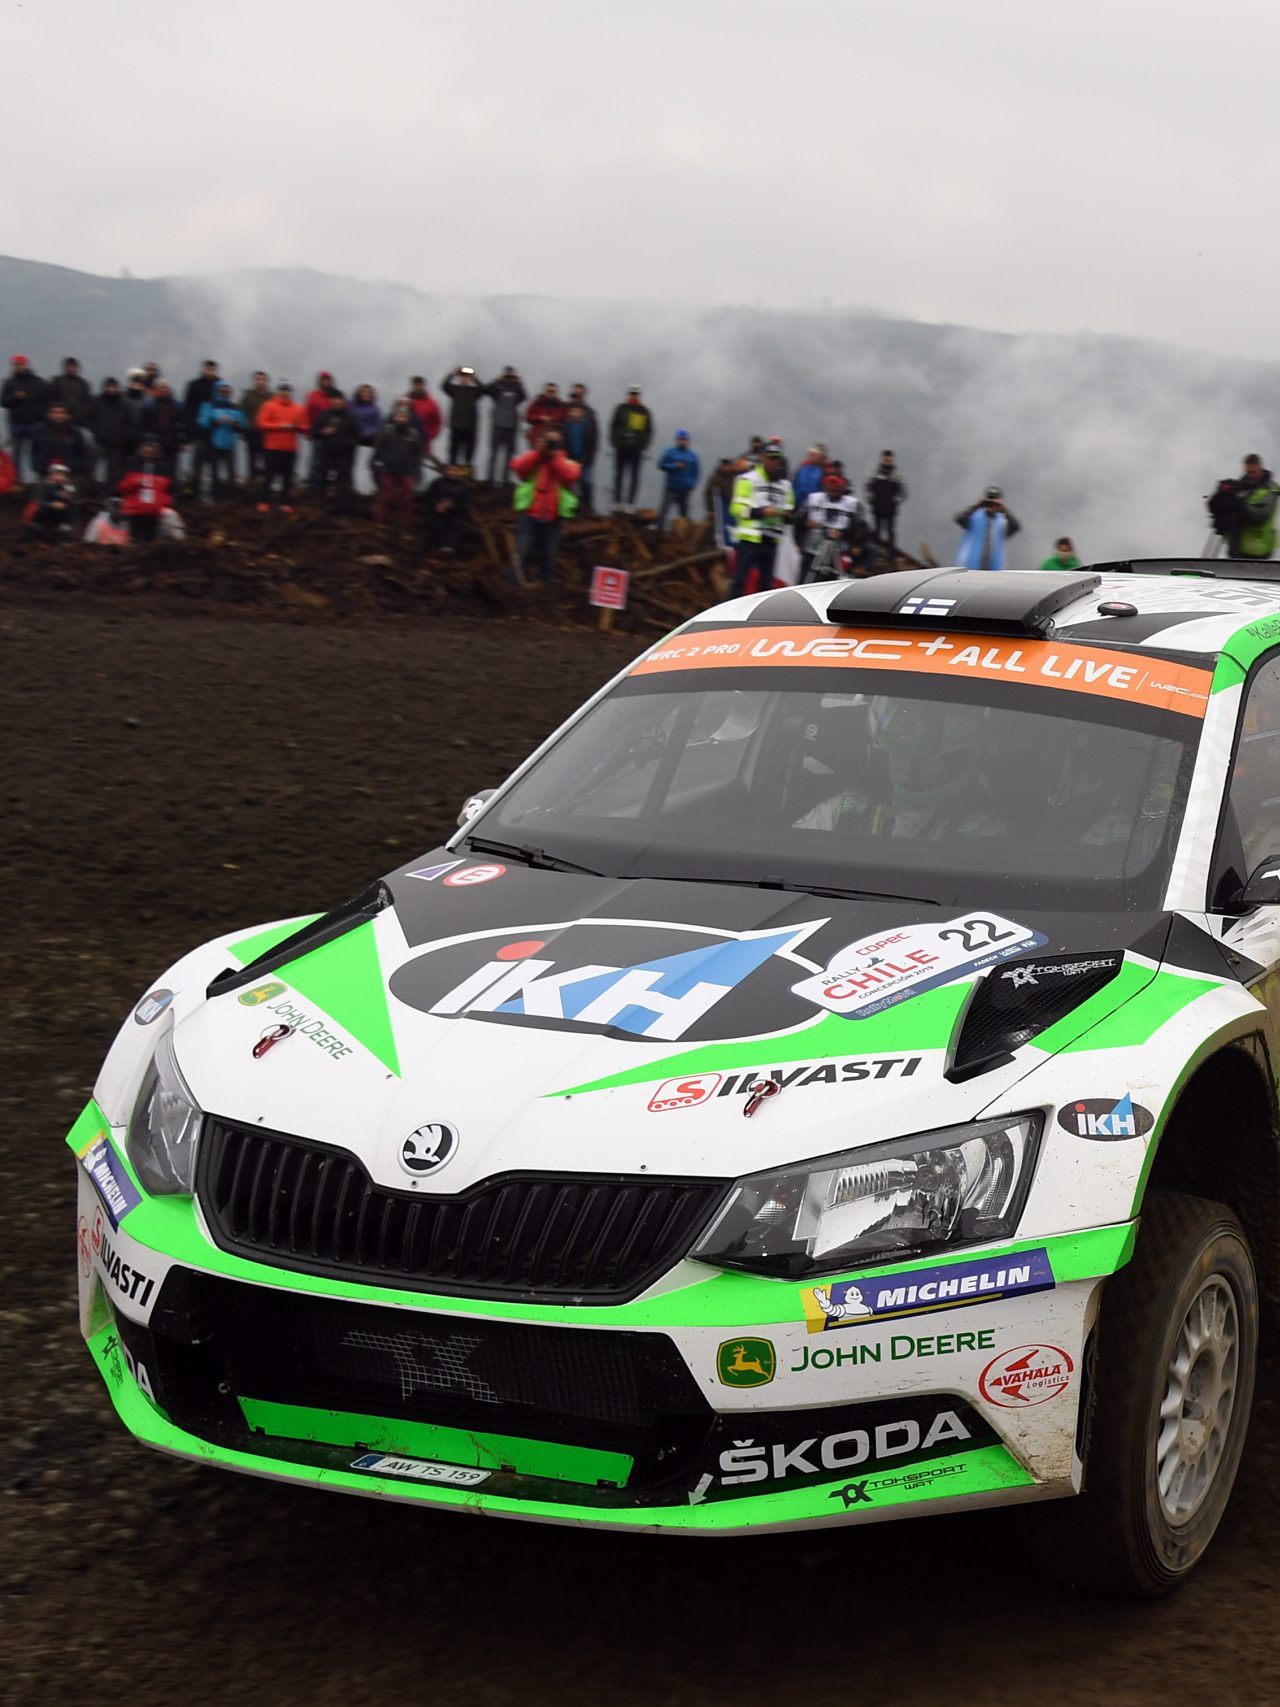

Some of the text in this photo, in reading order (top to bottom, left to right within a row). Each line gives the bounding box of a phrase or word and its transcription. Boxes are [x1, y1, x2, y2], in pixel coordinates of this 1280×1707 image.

[646, 648, 685, 662] WRC
[687, 647, 698, 657] 2
[702, 643, 741, 656] PRO
[948, 646, 1026, 673] ALL
[1040, 655, 1140, 689] LIVE
[938, 919, 1016, 952] 22
[821, 966, 861, 986] RALLY
[823, 949, 940, 1000] CHILE
[266, 1000, 353, 1060] JOHN DEERE
[93, 1162, 128, 1215] MICHELIN
[874, 1265, 1031, 1309] MICHELIN
[791, 1328, 996, 1372] JOHN DEERE
[1027, 1375, 1069, 1389] Logistics
[719, 1411, 972, 1485] ŠKODA
[382, 1461, 481, 1481] AW TS 159
